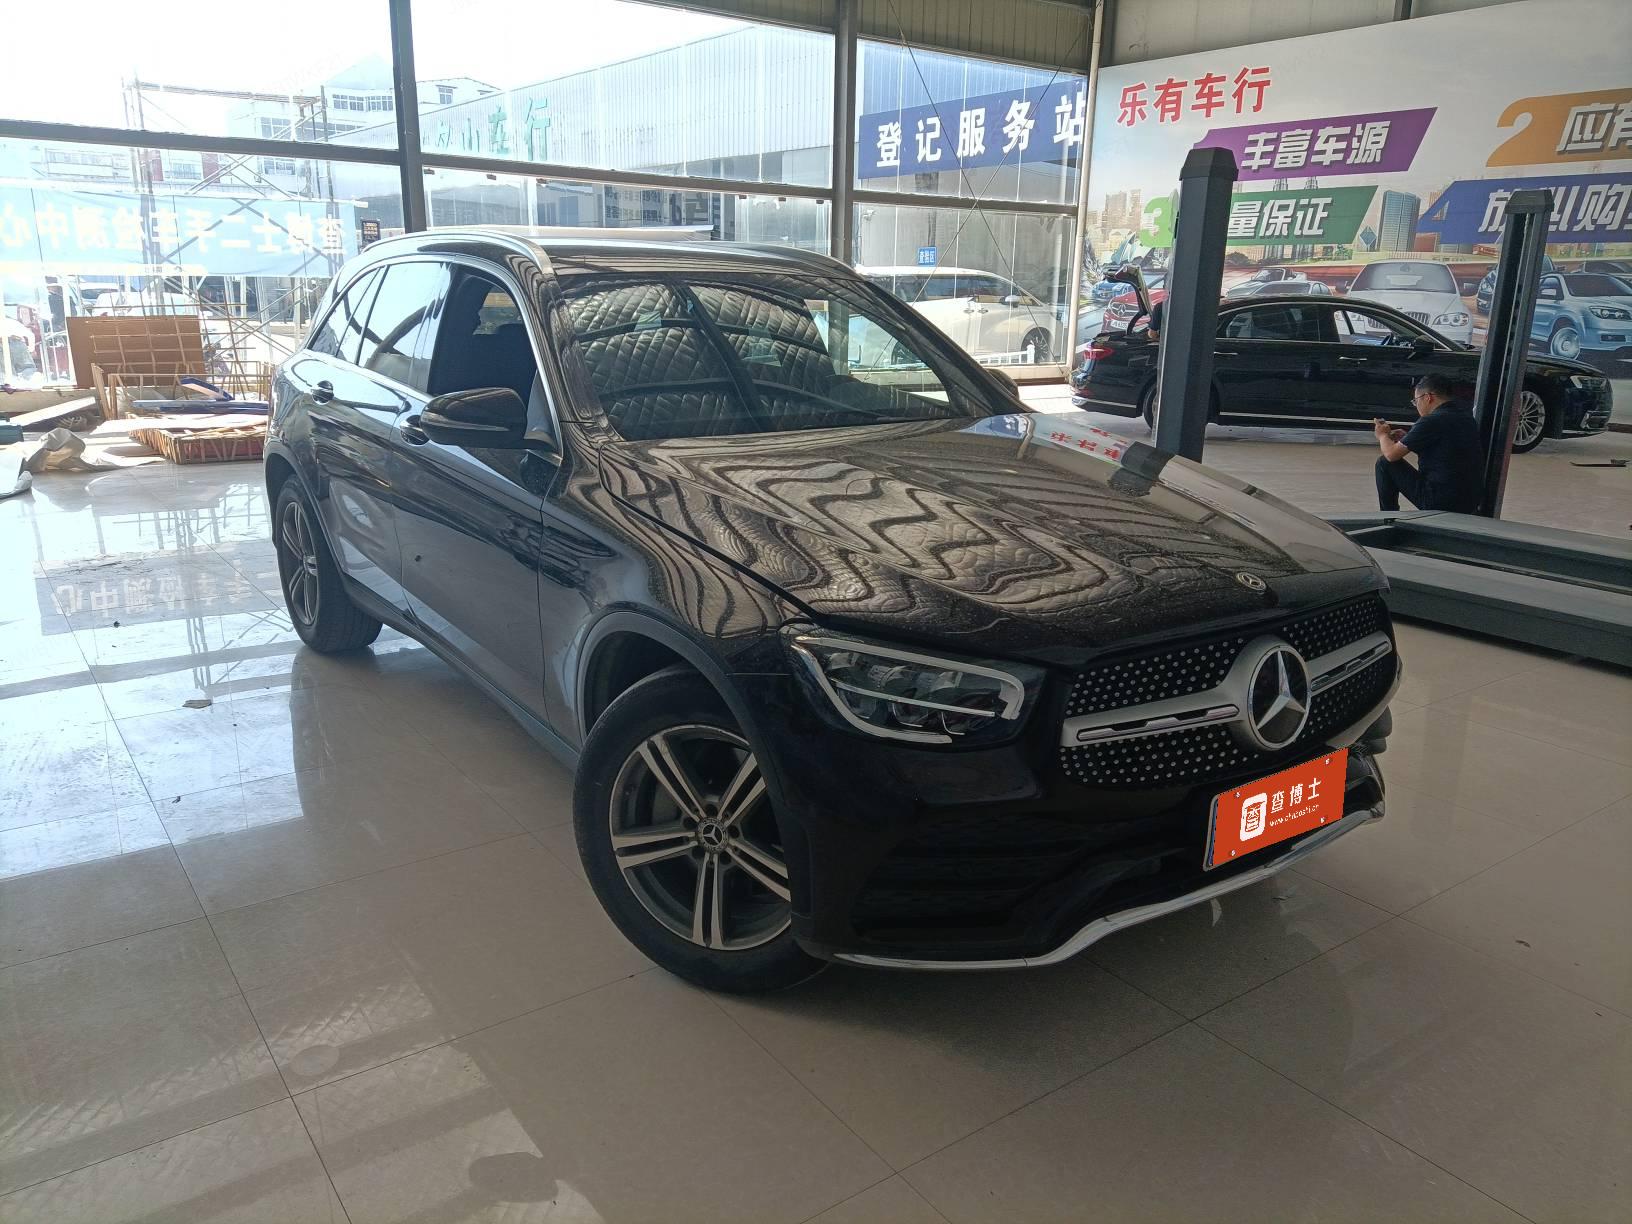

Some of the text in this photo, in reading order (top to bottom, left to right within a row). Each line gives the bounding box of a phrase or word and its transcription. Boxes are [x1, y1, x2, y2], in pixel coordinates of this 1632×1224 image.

[1116, 66, 1272, 127] 乐有车行
[876, 91, 1086, 168] 登记服务站
[1239, 120, 1392, 174] 丰富车源
[1486, 97, 1534, 168] 2
[1226, 196, 1333, 238] 量保证
